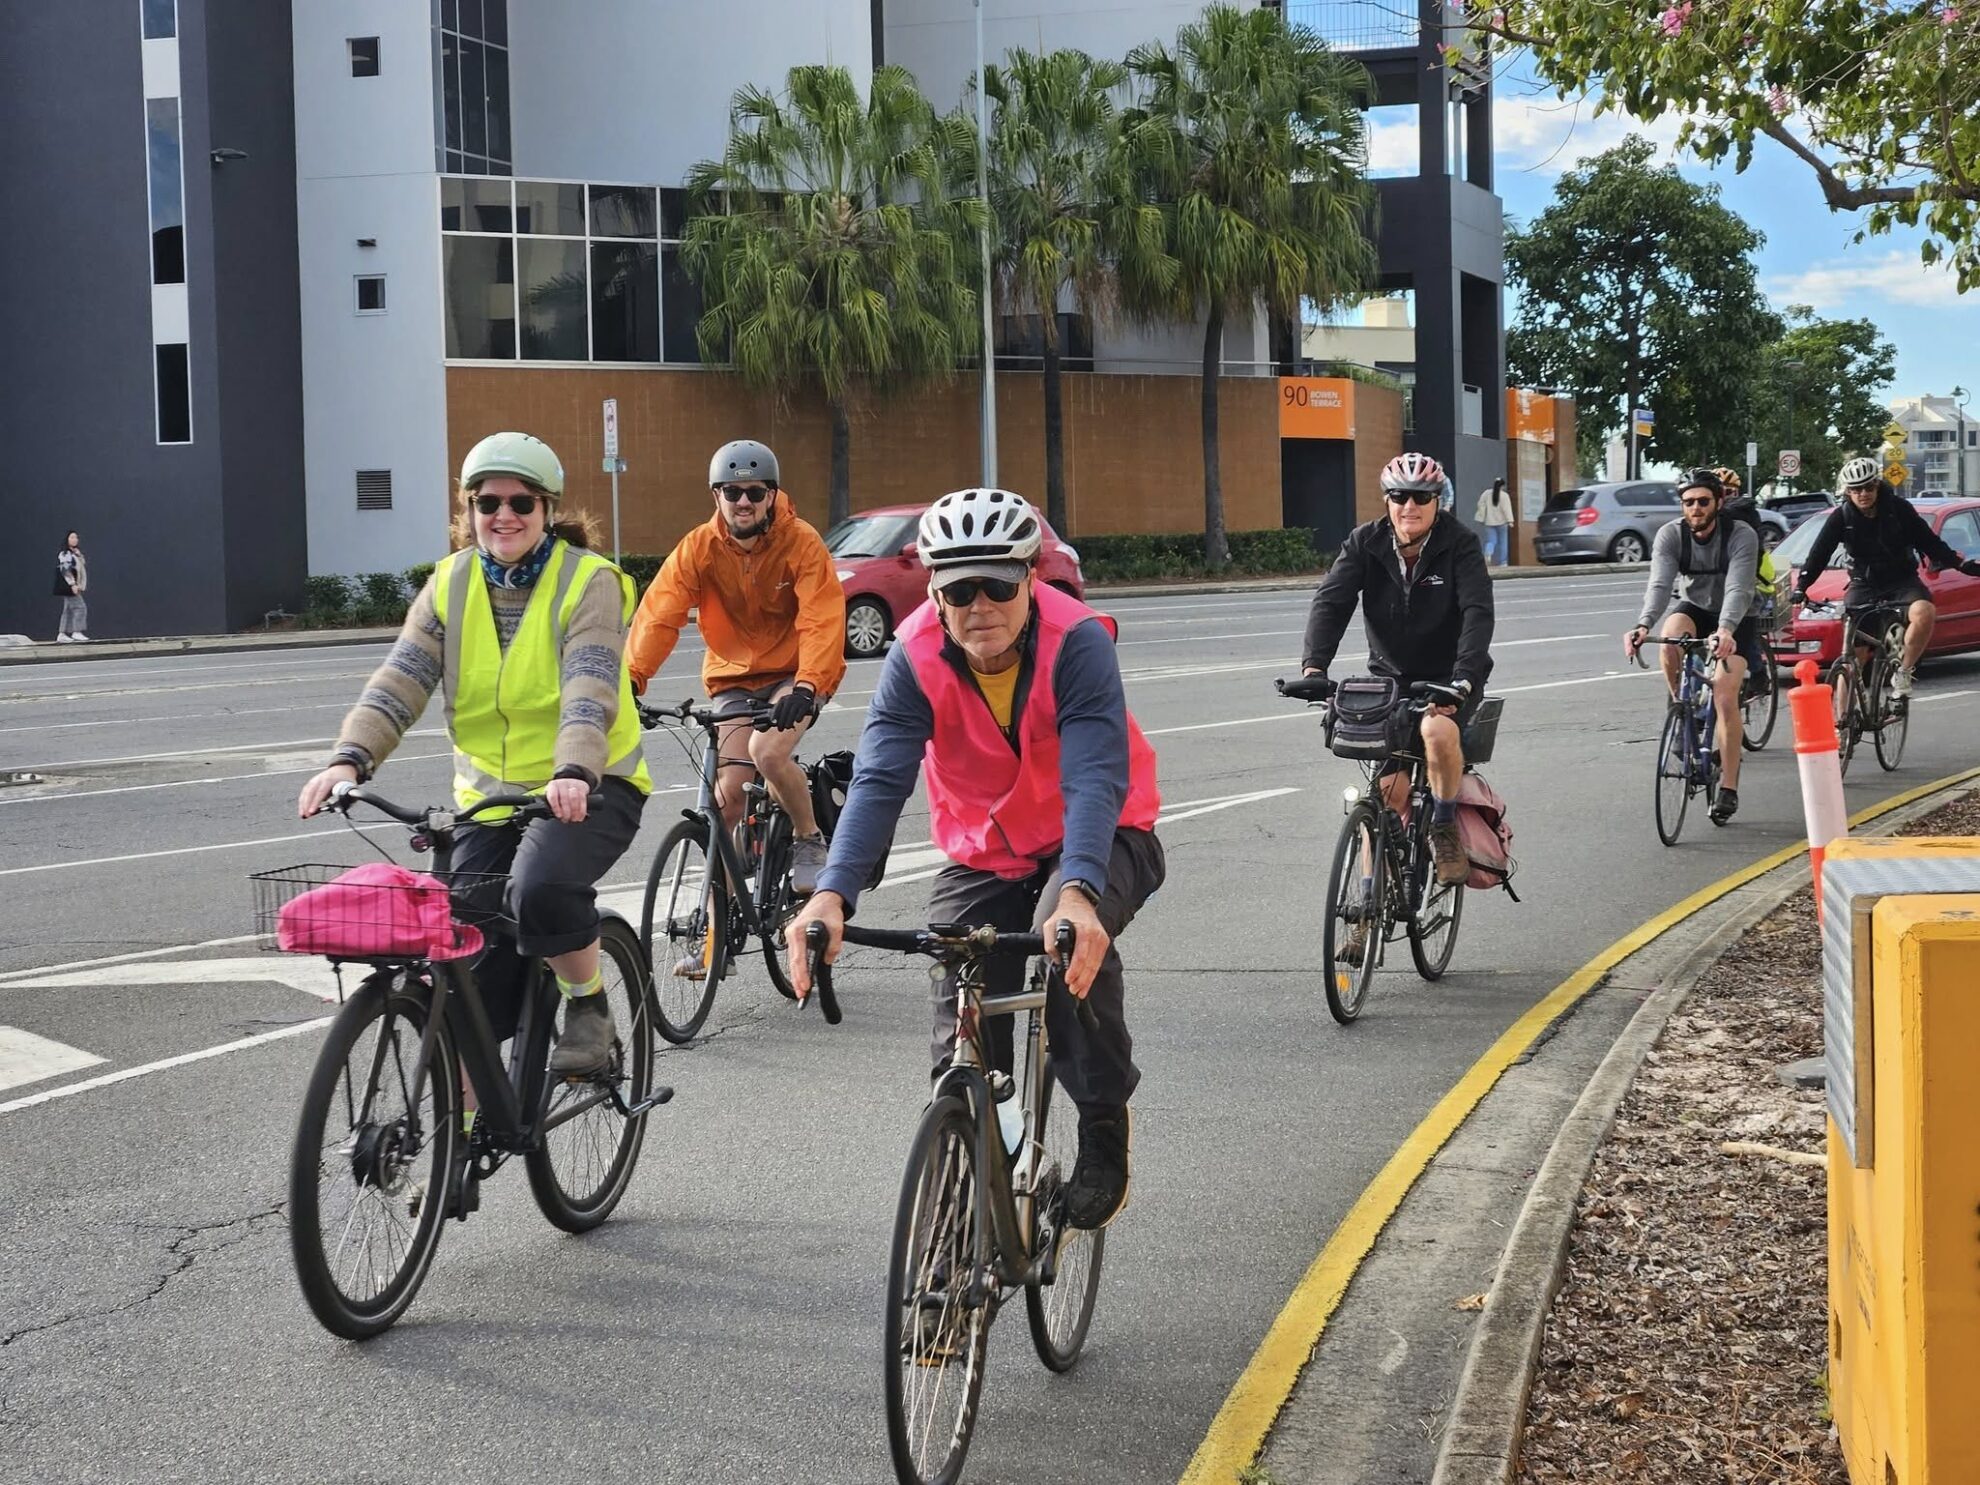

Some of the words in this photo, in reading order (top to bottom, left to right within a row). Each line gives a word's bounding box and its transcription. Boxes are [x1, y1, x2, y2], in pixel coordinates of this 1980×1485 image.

[1284, 385, 1308, 407] 90
[1310, 391, 1338, 399] BOWEN
[1310, 399, 1342, 408] TERRACE
[1783, 460, 1796, 468] 50
